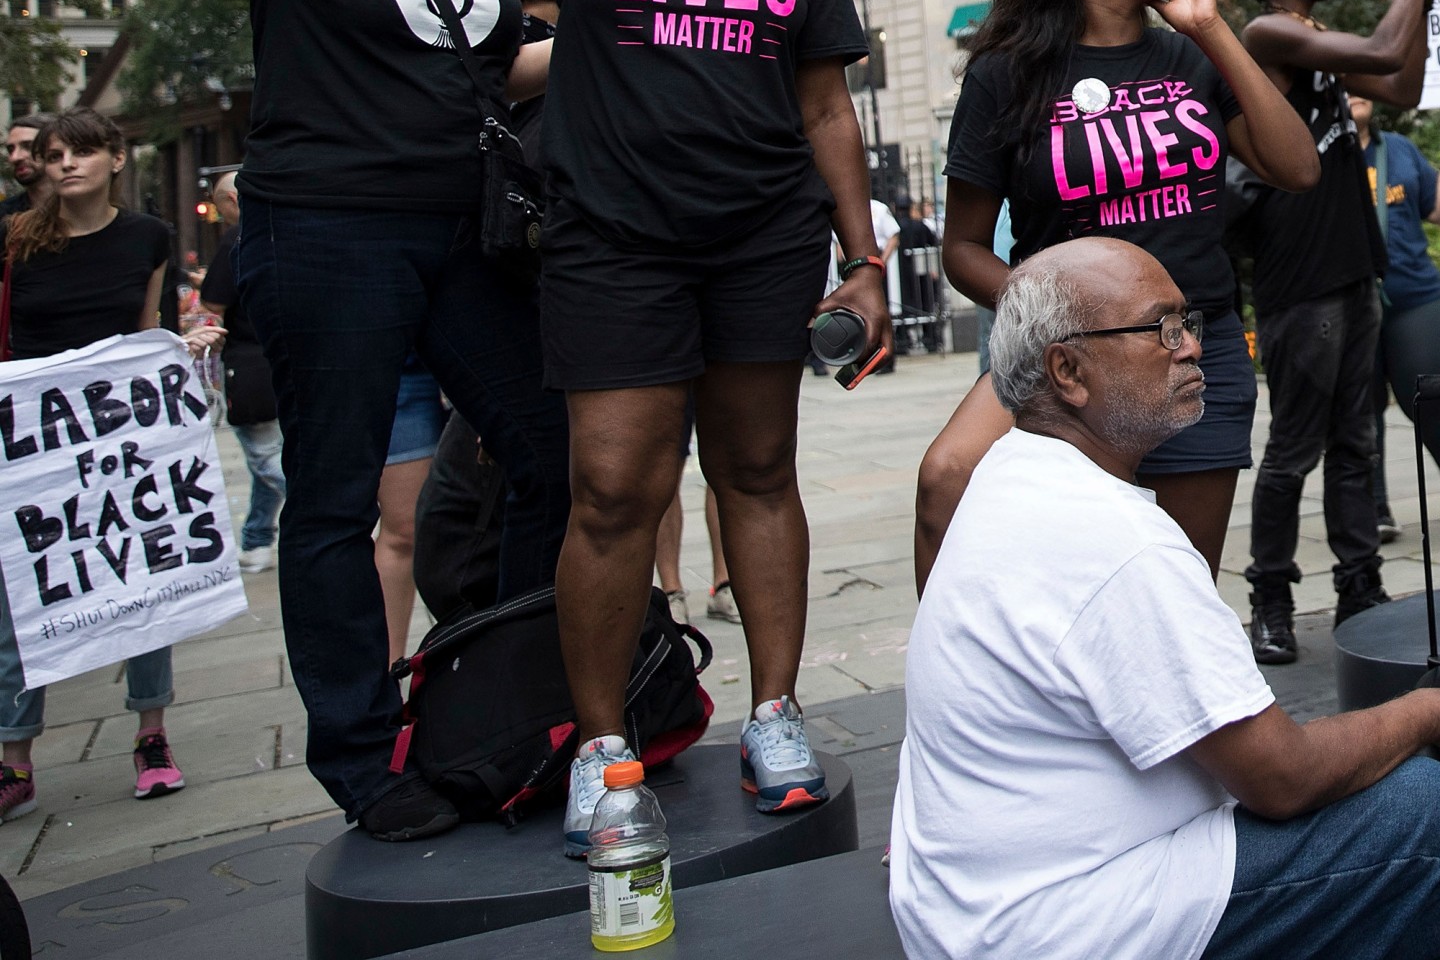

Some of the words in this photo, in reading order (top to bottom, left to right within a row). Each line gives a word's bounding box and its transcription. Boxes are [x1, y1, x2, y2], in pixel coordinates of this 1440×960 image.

[653, 12, 755, 54] MATTER
[1051, 99, 1220, 201] LIVES
[1100, 184, 1192, 227] MATTER
[0, 363, 209, 461] LABOR
[15, 455, 215, 553] BLACK
[76, 440, 154, 489] FOR
[33, 511, 225, 607] LIVES
